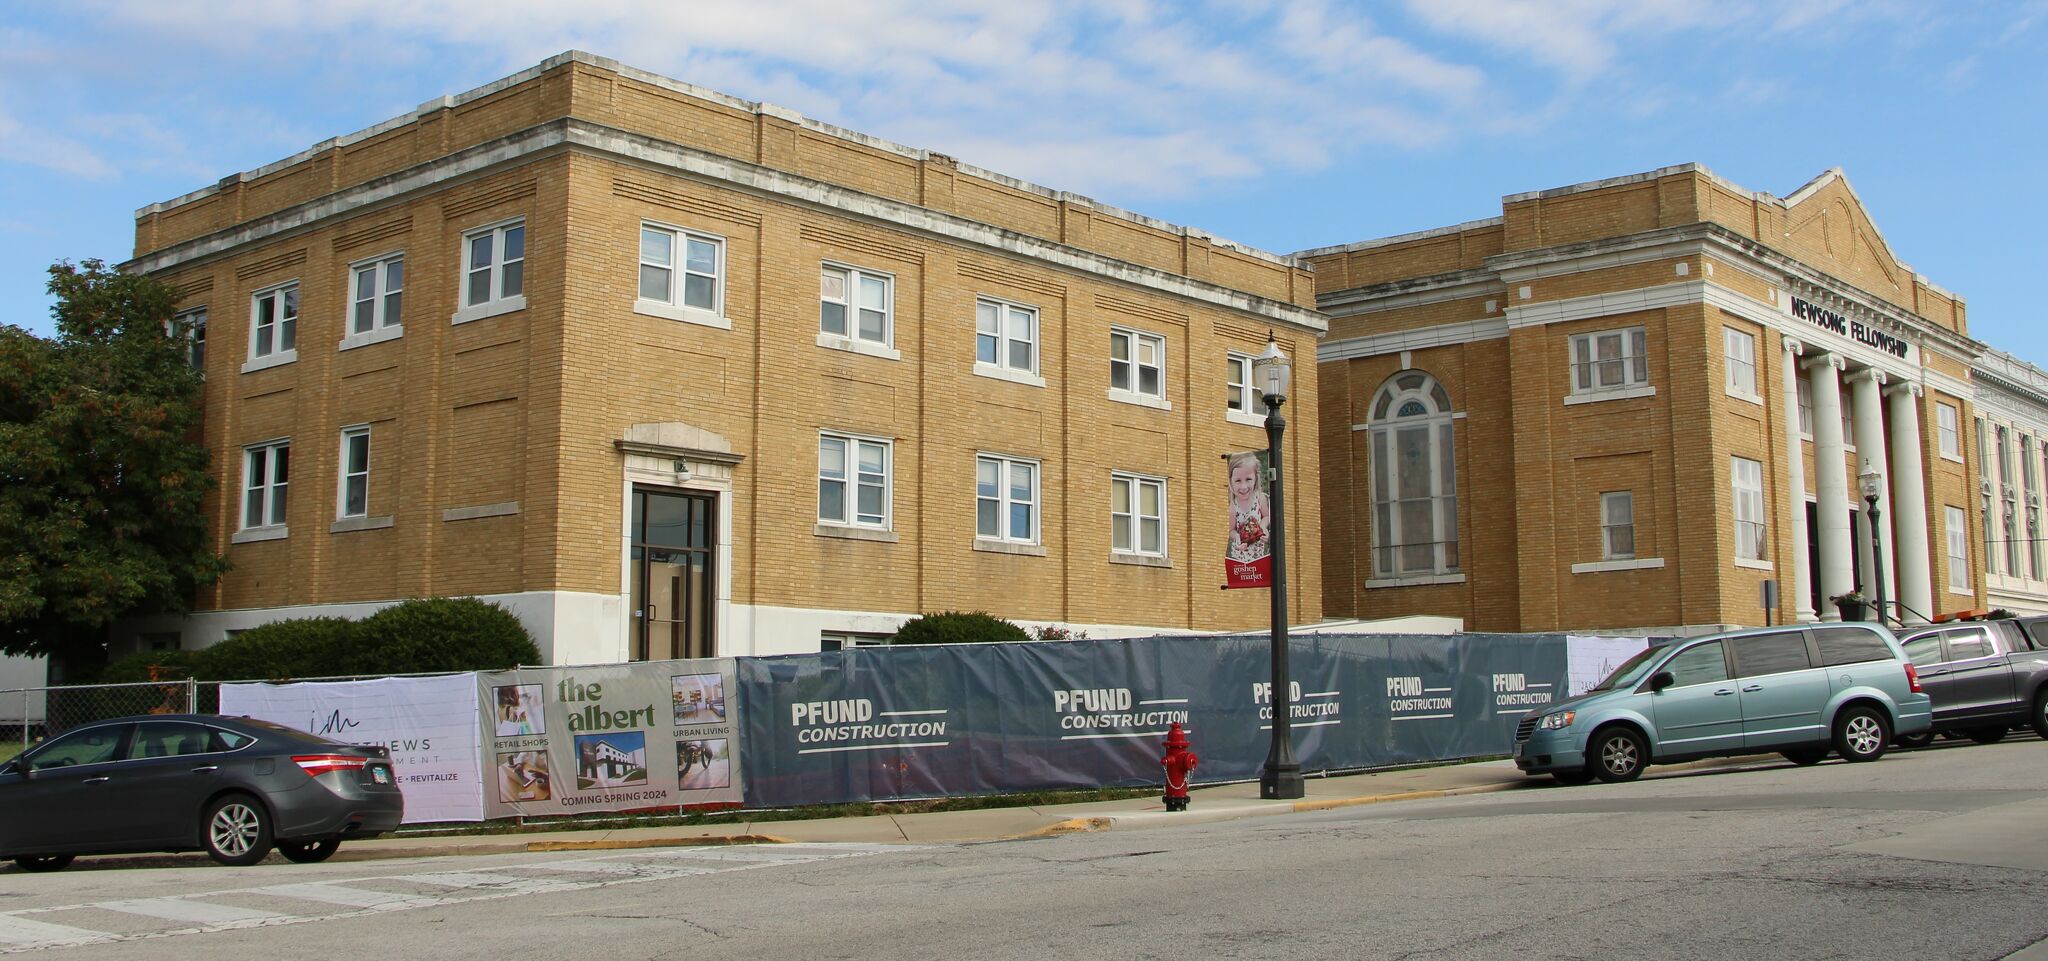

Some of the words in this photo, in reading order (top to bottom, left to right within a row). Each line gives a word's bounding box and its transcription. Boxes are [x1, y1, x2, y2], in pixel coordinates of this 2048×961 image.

[1791, 296, 1846, 336] NEWSONG
[1850, 320, 1908, 359] FELLOWSHIP
[557, 677, 602, 702] the
[1252, 681, 1301, 704] PFD
[1386, 676, 1422, 697] PFUND
[1492, 673, 1525, 692] PFUND
[1053, 688, 1132, 713] PFUND
[1390, 697, 1452, 712] CONSTRUCTION
[1496, 692, 1552, 706] CONSTRUCTION
[567, 703, 656, 731] albert
[791, 698, 873, 726] PFUND
[1060, 710, 1189, 730] CONSTRUCTION
[1259, 702, 1340, 719] COTRUCTION
[673, 728, 701, 737] URBAN
[703, 727, 730, 736] LIVING
[798, 721, 946, 743] CONSTRUCTION
[494, 740, 521, 749] RETAIL
[522, 738, 549, 748] SHOPS
[410, 773, 459, 782] REVITALIZE
[561, 795, 602, 806] COMING
[604, 792, 641, 803] SPRING
[643, 790, 667, 799] 2024
